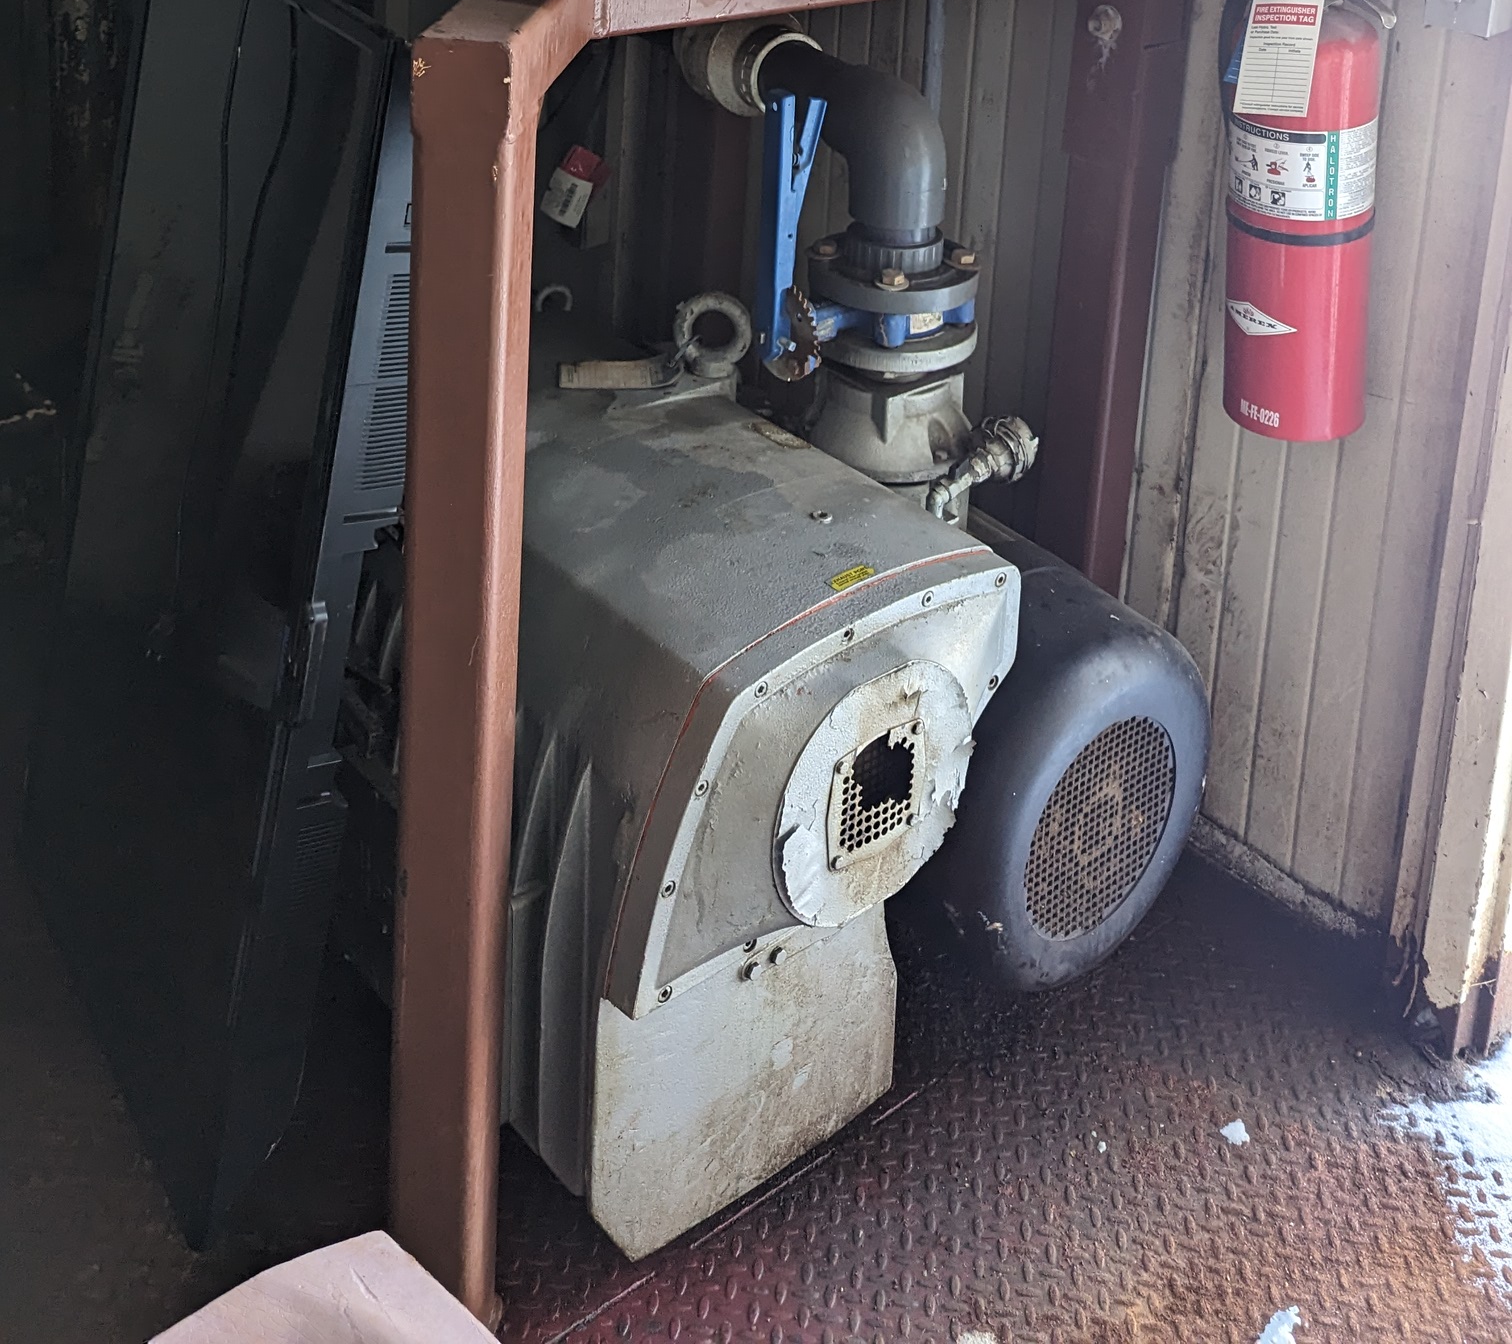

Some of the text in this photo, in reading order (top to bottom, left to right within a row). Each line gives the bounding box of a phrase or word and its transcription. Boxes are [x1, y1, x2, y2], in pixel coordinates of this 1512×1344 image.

[1255, 14, 1314, 23] INSPECTION TAG
[1269, 6, 1316, 14] EXTINGUISHER
[1328, 134, 1337, 218] HALOTRON
[1230, 305, 1278, 330] AMEREX
